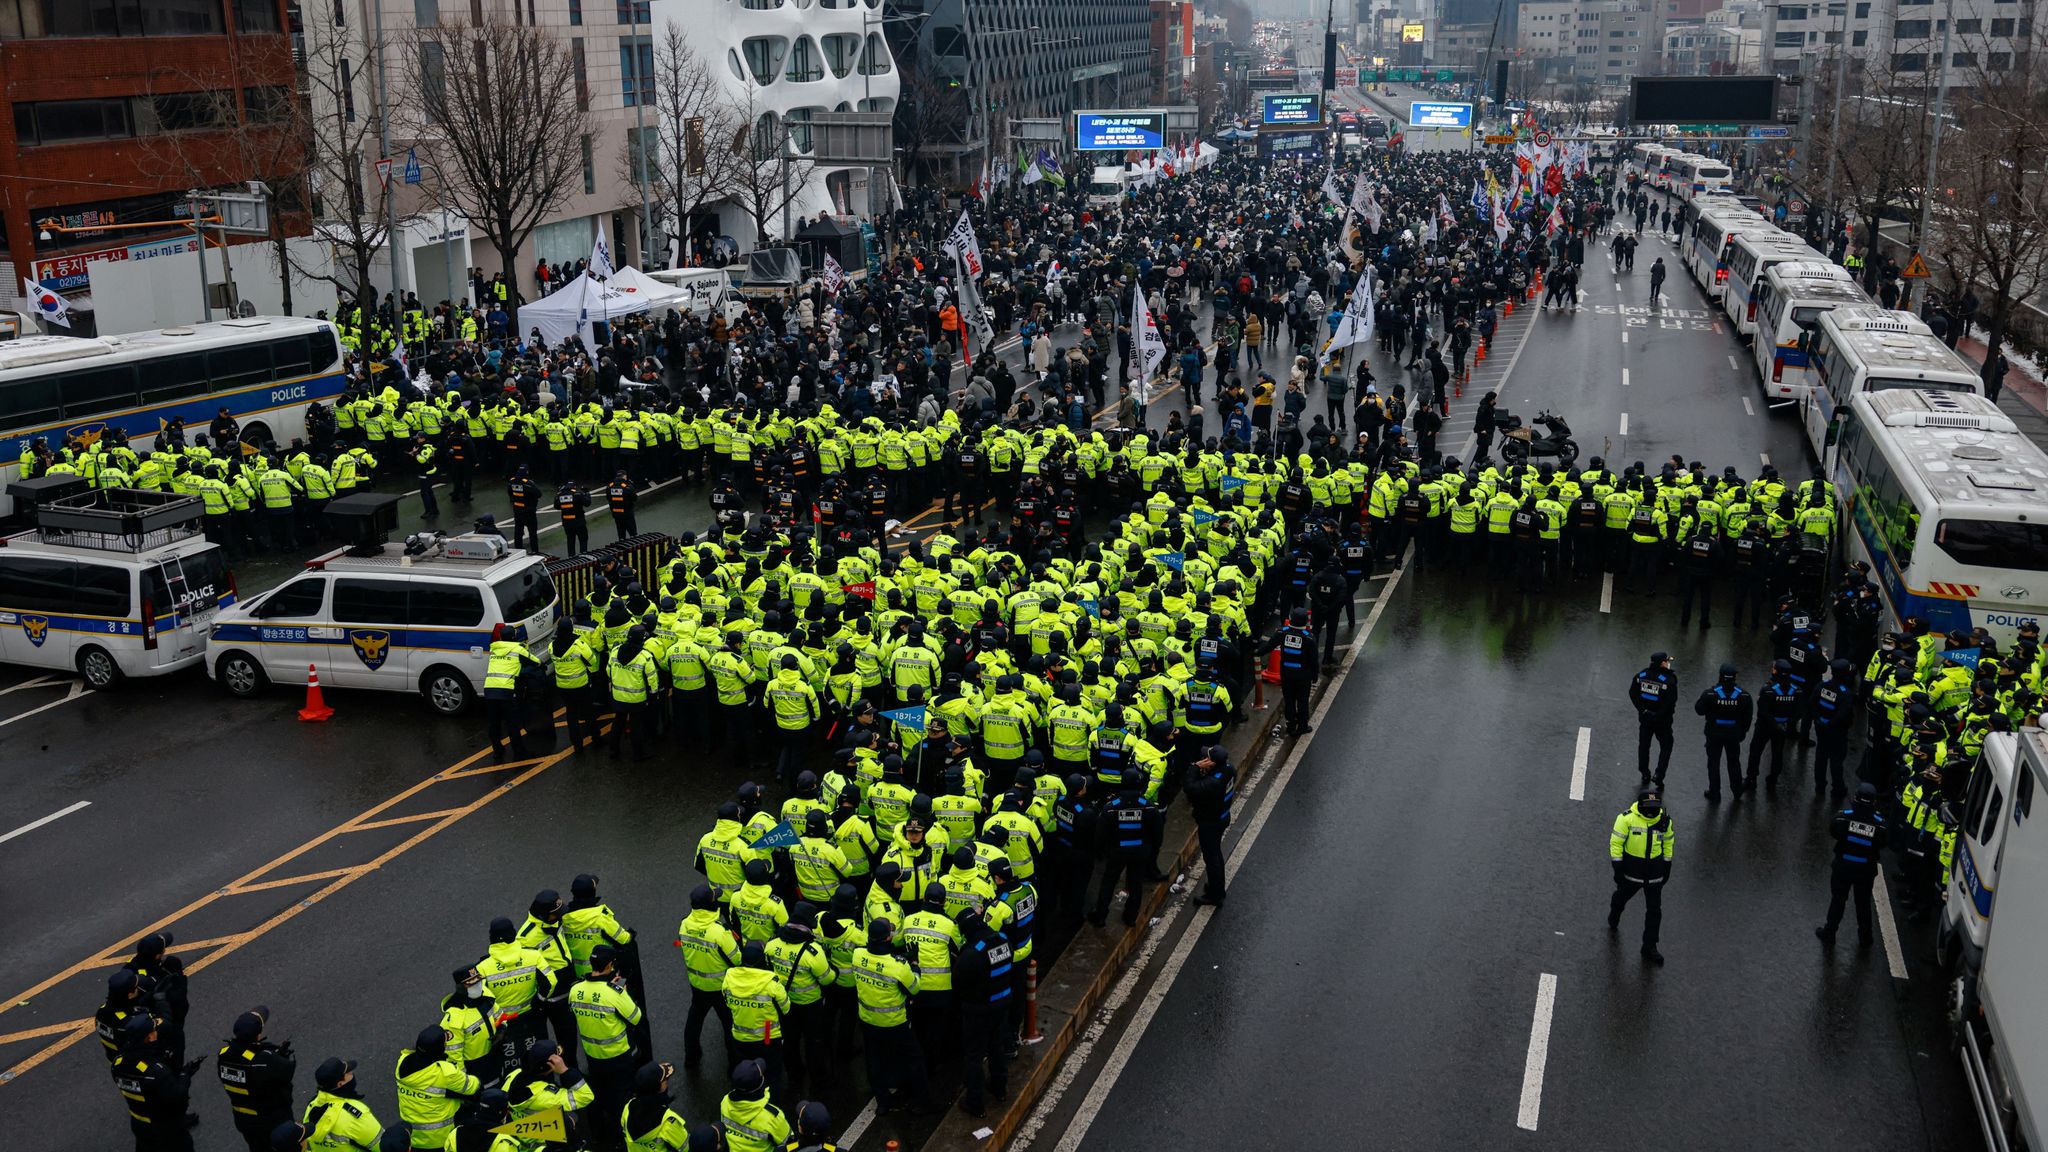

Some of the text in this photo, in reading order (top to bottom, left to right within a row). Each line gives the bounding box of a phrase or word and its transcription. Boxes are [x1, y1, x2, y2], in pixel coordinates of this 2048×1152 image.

[1538, 135, 1547, 143] 60
[697, 279, 719, 291] Sajahoo
[271, 386, 307, 403] POLICE
[180, 583, 215, 603] POLICE
[532, 610, 549, 622] POLICE
[107, 621, 130, 633] 경찰
[263, 628, 305, 640] 방송조명 62
[1951, 652, 1977, 662] 16기-2
[895, 711, 922, 722] 18기-2
[1055, 723, 1082, 731] POLICE
[874, 803, 900, 811] POLICE
[763, 829, 794, 846] 18기-3
[705, 855, 733, 866] POLICE
[794, 859, 823, 869] POLICE
[738, 914, 767, 926] POLICE
[906, 936, 939, 944] POLICE
[682, 942, 711, 953] POLICE
[492, 974, 532, 988] POLICE
[856, 974, 889, 988] POLICE
[728, 999, 764, 1009] POLICE
[574, 1009, 606, 1020] POLICE
[515, 1120, 559, 1134] 27기-1
